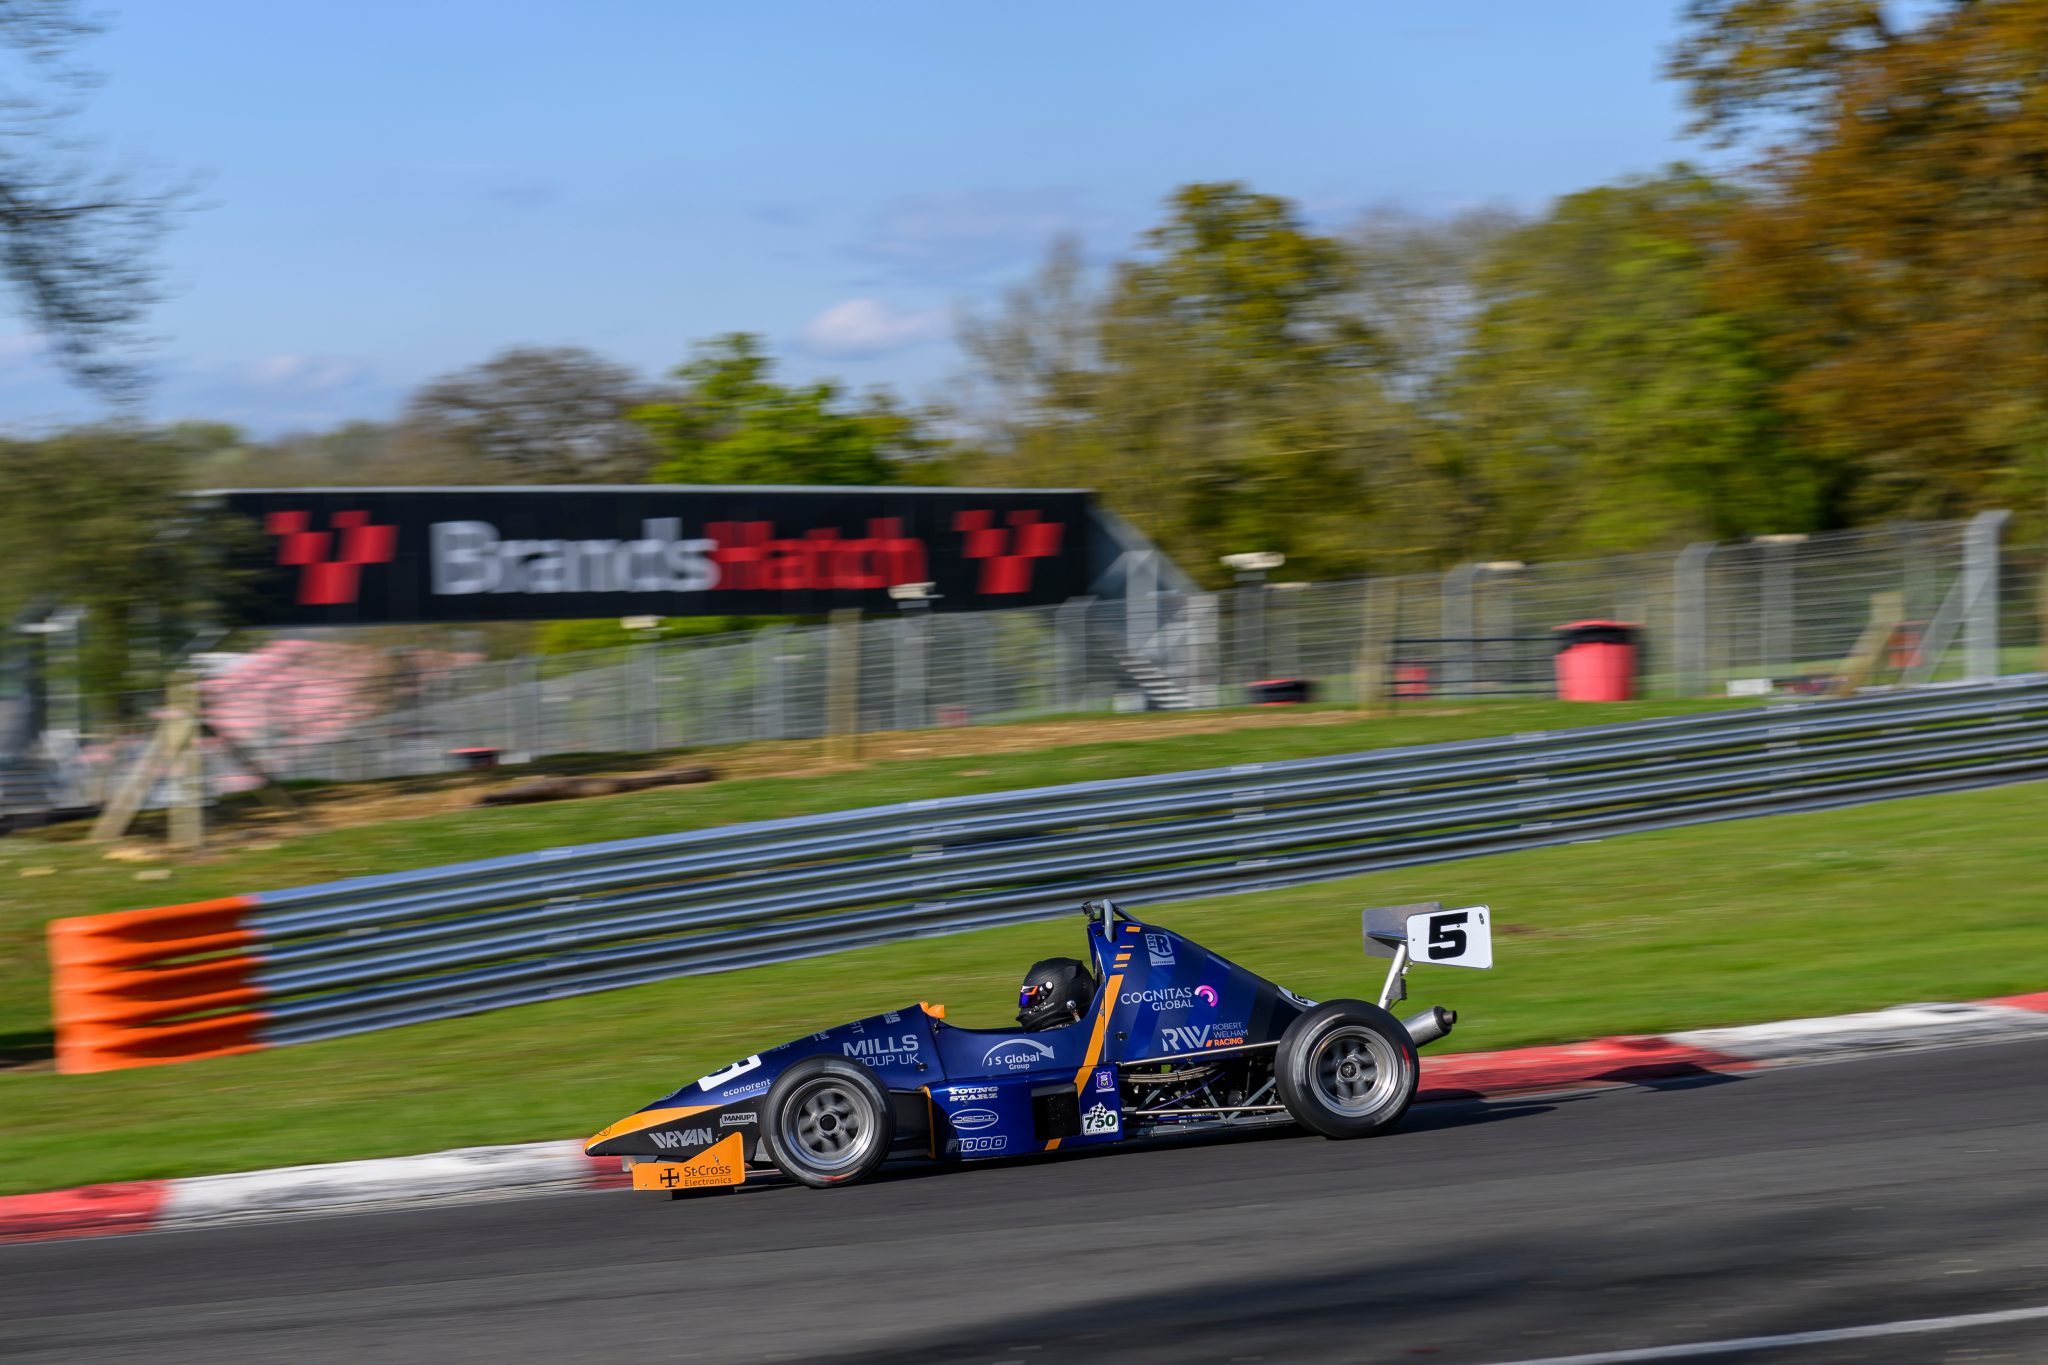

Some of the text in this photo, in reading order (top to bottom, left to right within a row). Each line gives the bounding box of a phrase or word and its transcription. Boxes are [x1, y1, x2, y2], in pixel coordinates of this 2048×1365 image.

[1428, 912, 1468, 960] 5
[1121, 987, 1192, 1004] COGNITAS
[1152, 1000, 1194, 1011] GLOBAL
[1212, 1022, 1242, 1030] ROBERT
[1213, 1029, 1249, 1039] WELHAM
[843, 1034, 919, 1056] MILLS
[1214, 1037, 1244, 1047] RACING
[899, 1053, 922, 1065] UK
[988, 1051, 1040, 1066] J S Global
[723, 1078, 771, 1097] econorent
[949, 1086, 999, 1095] YOUNG
[723, 1114, 755, 1122] MANUP?
[1084, 1114, 1116, 1130] 750
[684, 1177, 732, 1187] Electronics
